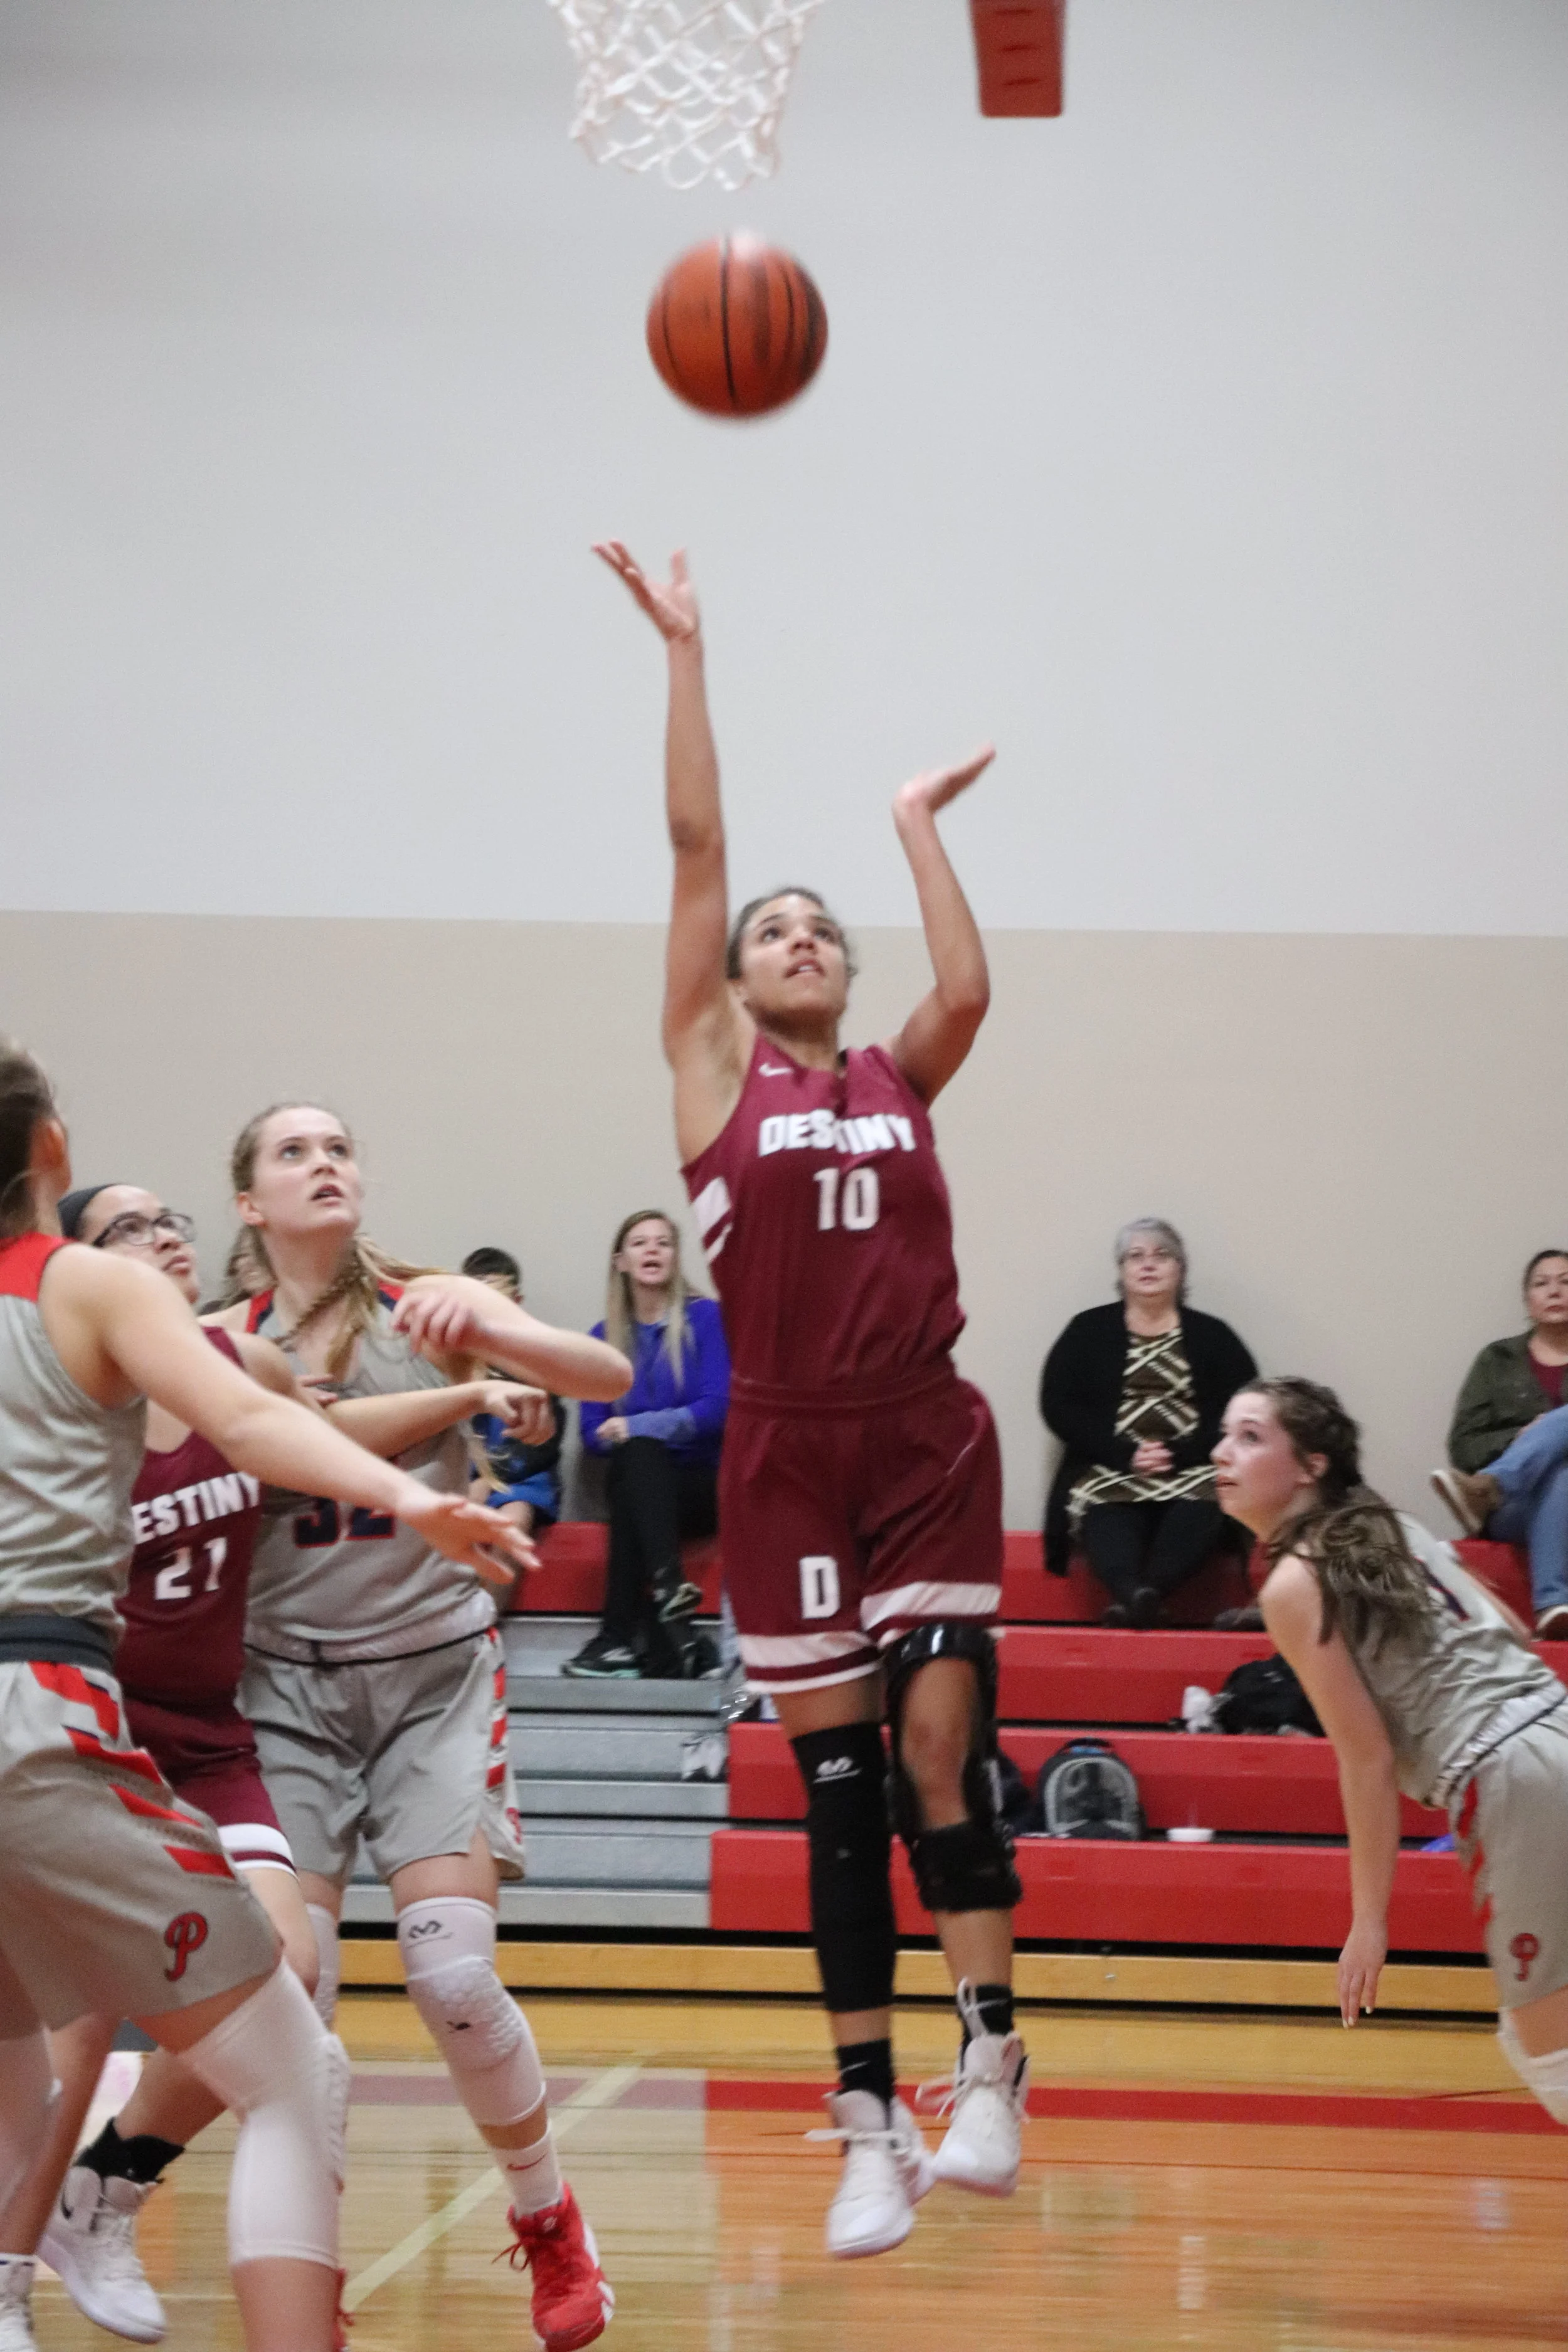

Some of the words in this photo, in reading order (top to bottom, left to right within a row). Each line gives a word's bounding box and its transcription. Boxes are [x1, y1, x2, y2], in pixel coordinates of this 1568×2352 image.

[759, 1108, 916, 1157] DESTINY
[813, 1167, 879, 1230] 10
[130, 1471, 260, 1545] ESTINY
[155, 1536, 227, 1600] 21
[799, 1555, 840, 1618] D
[164, 1911, 208, 1982] P
